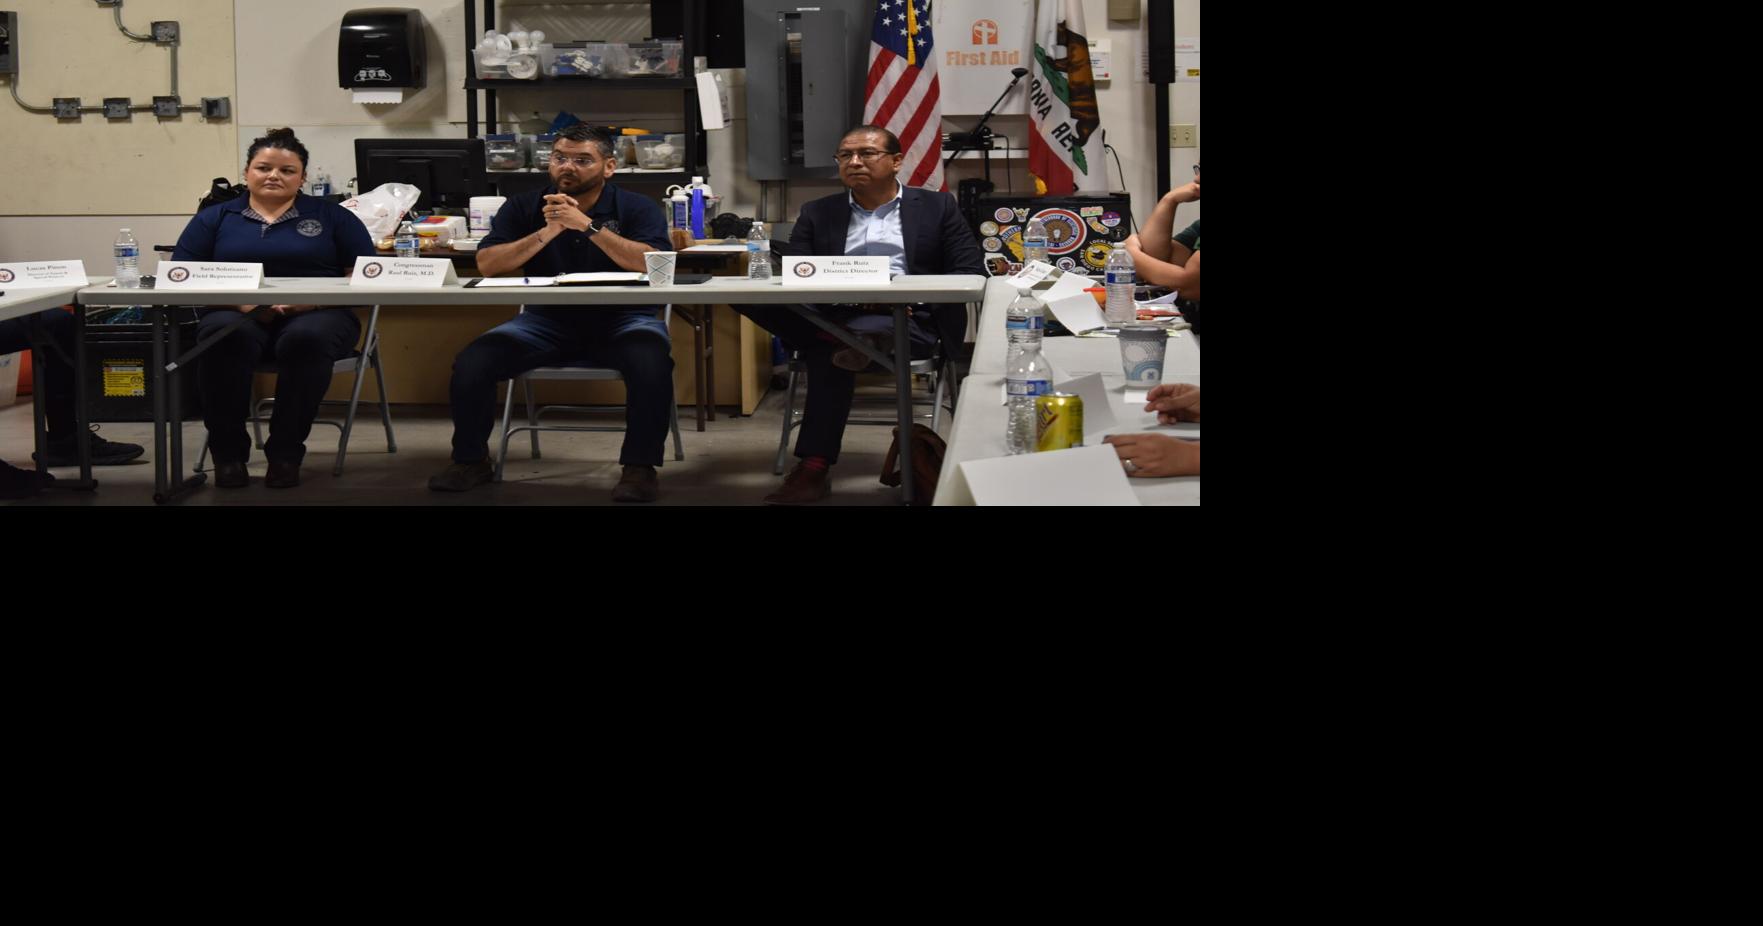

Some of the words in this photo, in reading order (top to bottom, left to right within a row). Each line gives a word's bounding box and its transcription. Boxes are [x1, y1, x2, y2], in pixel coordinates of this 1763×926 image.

[946, 50, 986, 66] First
[990, 50, 1020, 66] Aid
[393, 261, 434, 269] Congressman
[832, 259, 852, 267] Frank
[823, 267, 849, 275] District
[850, 267, 879, 275] Director
[209, 273, 254, 281] Representative
